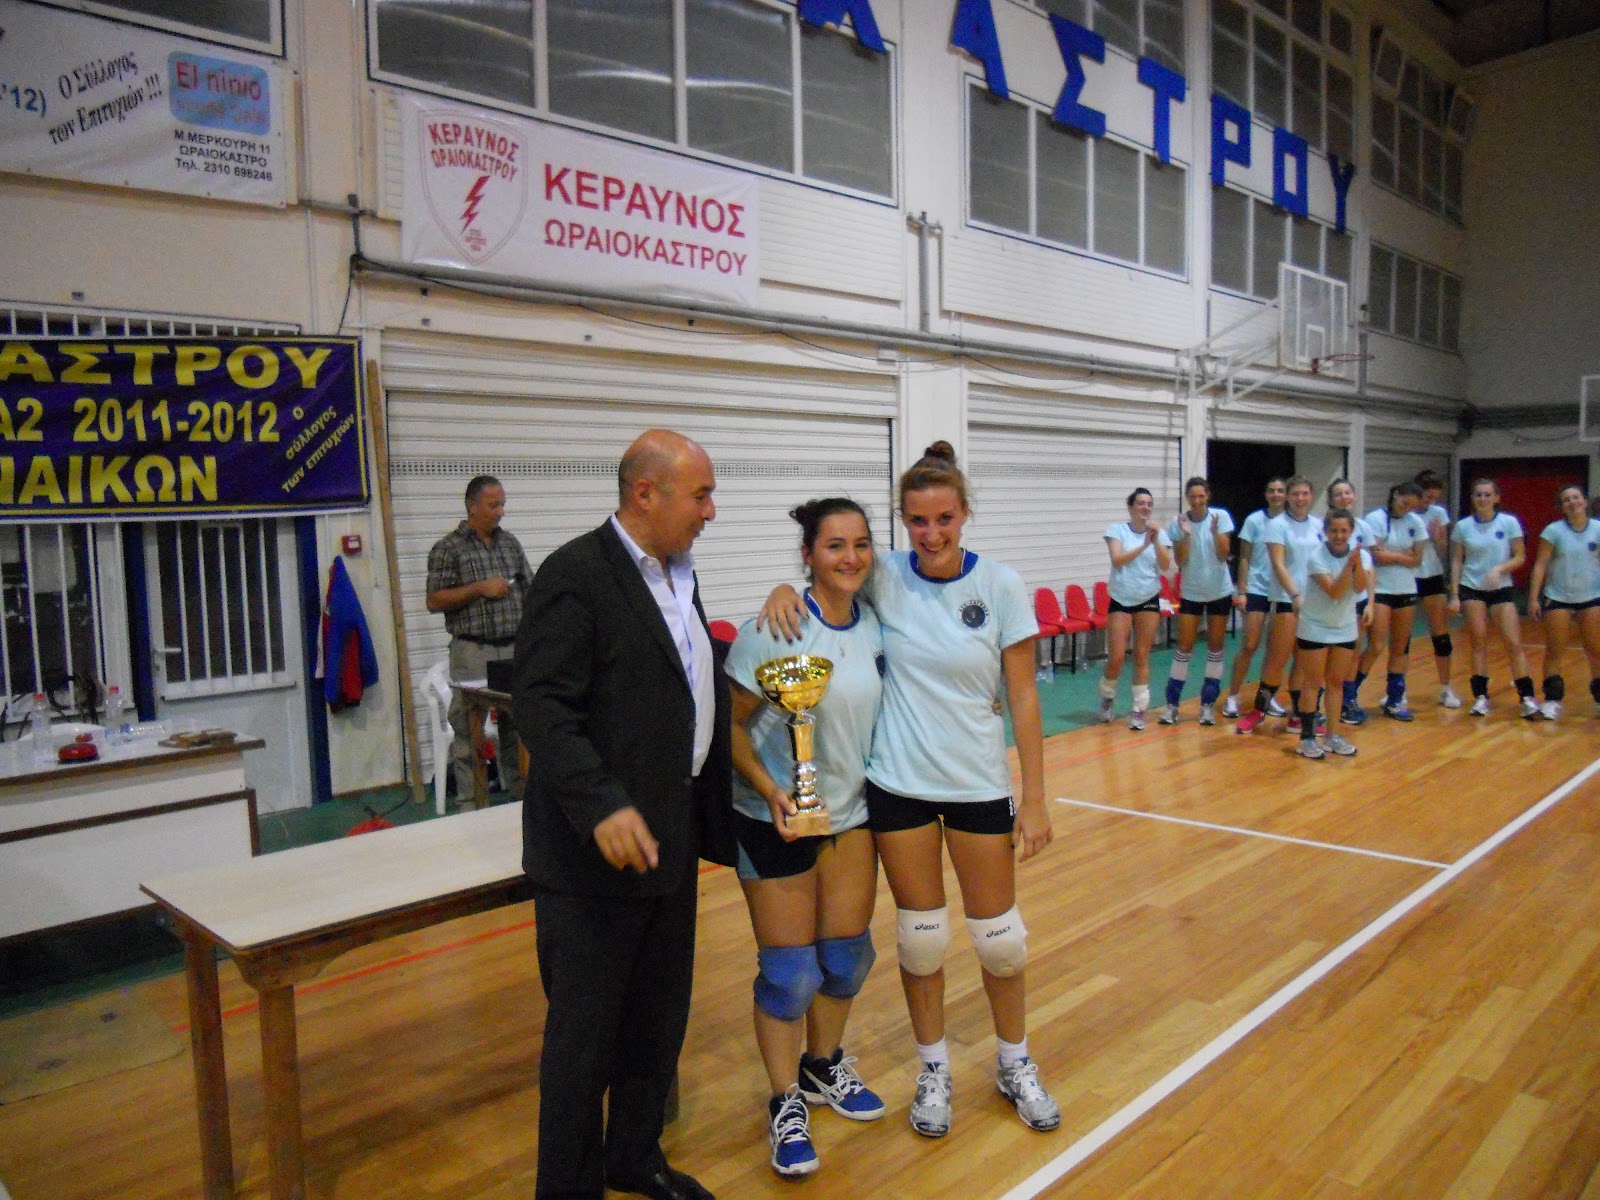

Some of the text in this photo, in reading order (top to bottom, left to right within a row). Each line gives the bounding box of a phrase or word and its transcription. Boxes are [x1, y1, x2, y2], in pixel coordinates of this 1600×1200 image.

[176, 61, 198, 91] El
[179, 145, 267, 168] ΩΡΑΙΟΚΑΣΤΡΟ
[259, 143, 271, 155] 11
[428, 123, 519, 163] ΚΕΡΑΥΝΟΣ
[203, 160, 231, 175] 2310
[431, 148, 518, 182] ΩΡΑΙΟΚΑΣΤΡΟΥ
[544, 164, 746, 238] ΚΕΡΑΥΝΟΣ
[544, 218, 748, 276] ΩΡΑΙΟΚΑΣΤΡΟΥ
[73, 397, 280, 442] 2011-2012
[922, 922, 940, 931] asics
[993, 925, 1011, 937] asics
